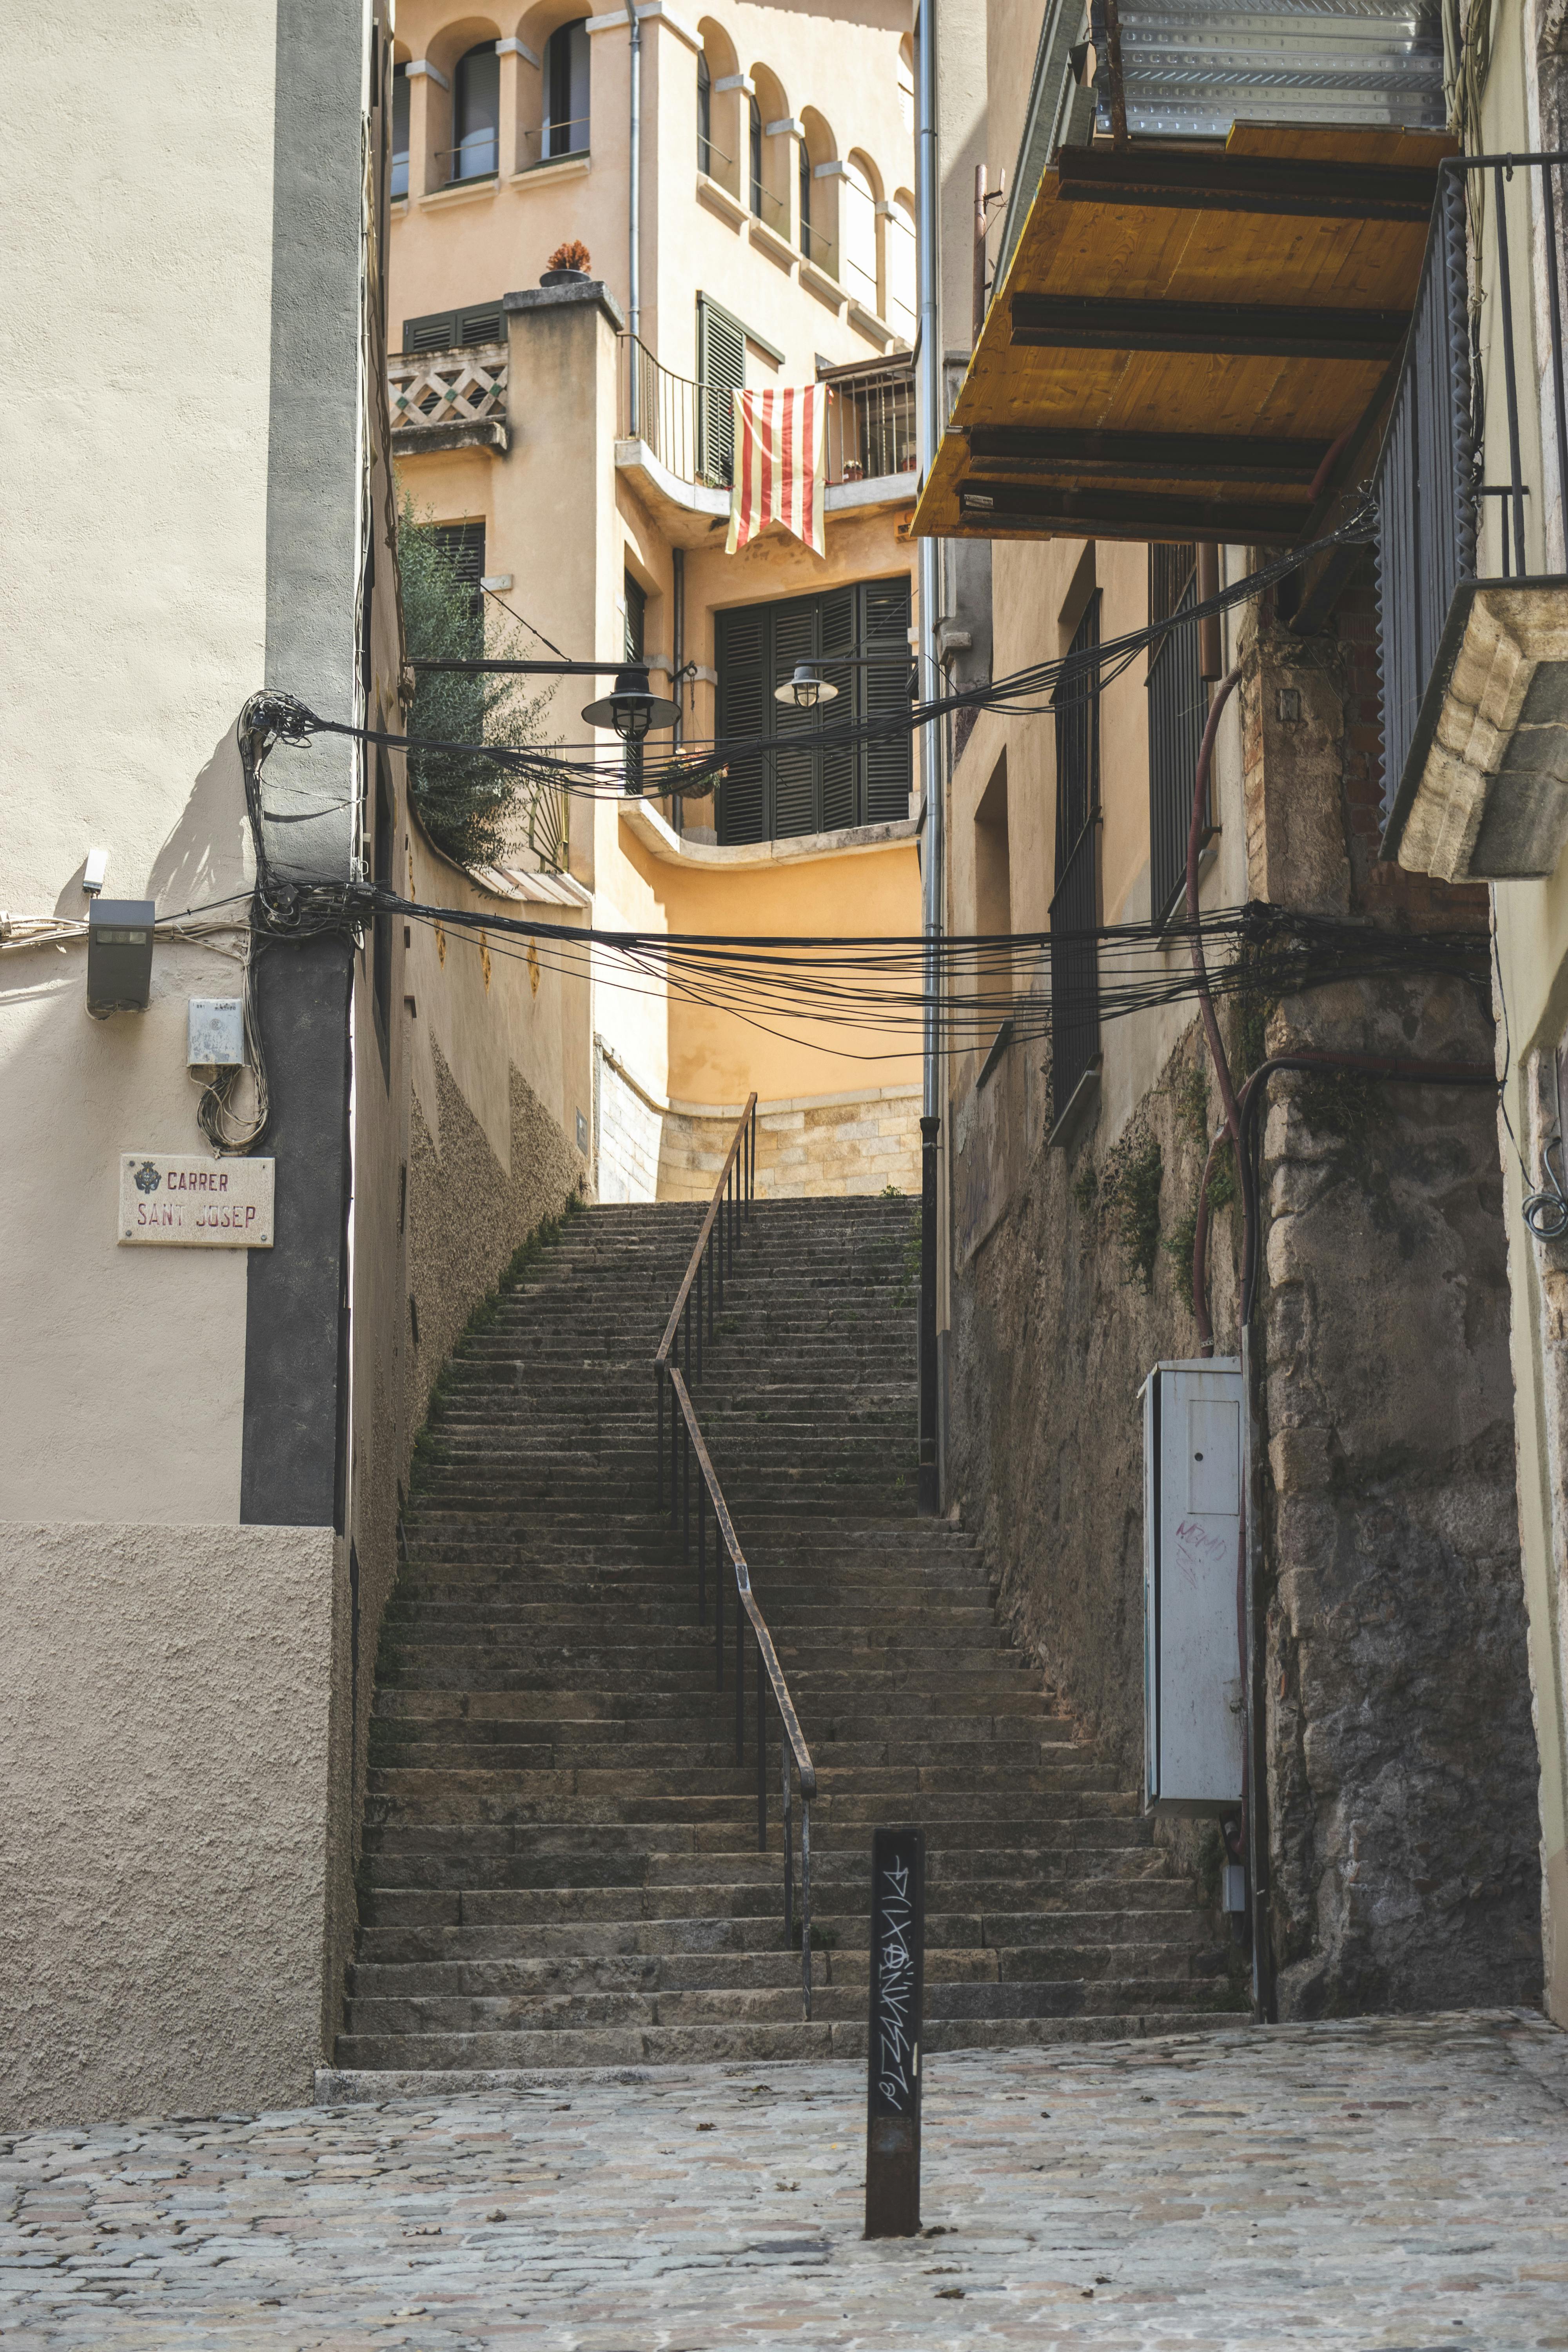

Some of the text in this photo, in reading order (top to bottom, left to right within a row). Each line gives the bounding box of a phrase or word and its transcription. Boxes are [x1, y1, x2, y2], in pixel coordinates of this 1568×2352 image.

[167, 1172, 228, 1192] CARRER
[138, 1203, 256, 1229] SANT JOSEP
